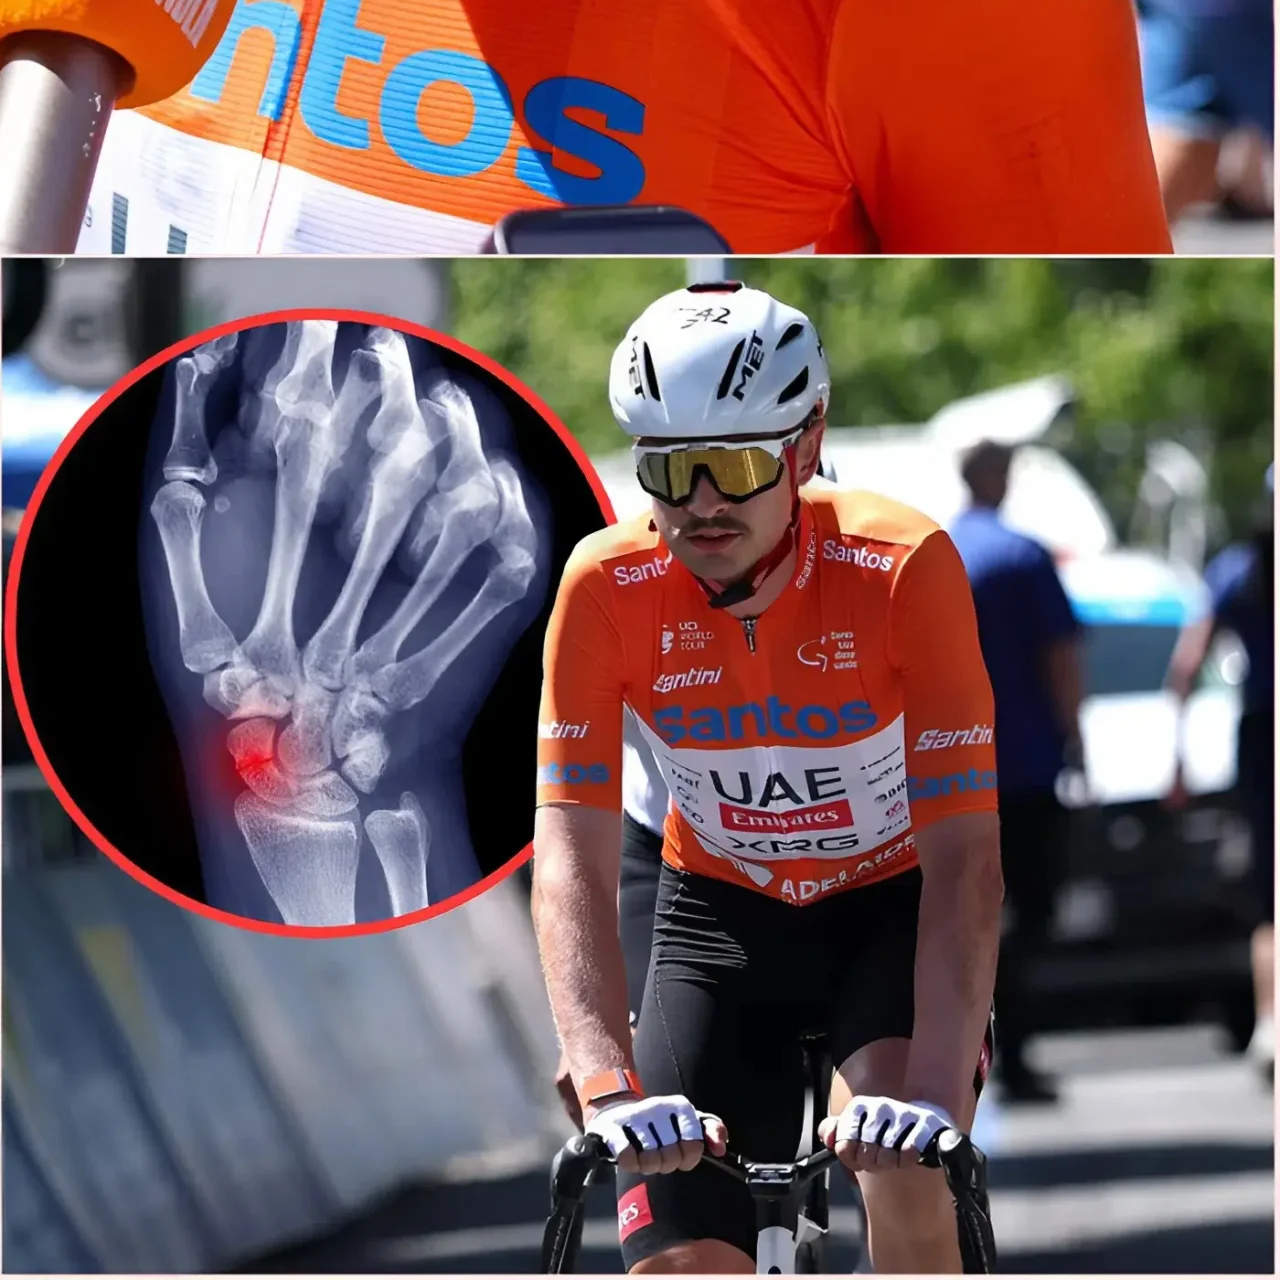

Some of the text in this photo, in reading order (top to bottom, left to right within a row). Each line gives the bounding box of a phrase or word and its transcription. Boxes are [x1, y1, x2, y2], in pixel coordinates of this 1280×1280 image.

[732, 329, 765, 402] MET
[613, 552, 673, 586] Sant
[823, 539, 894, 572] Santos
[708, 766, 847, 808] UAE
